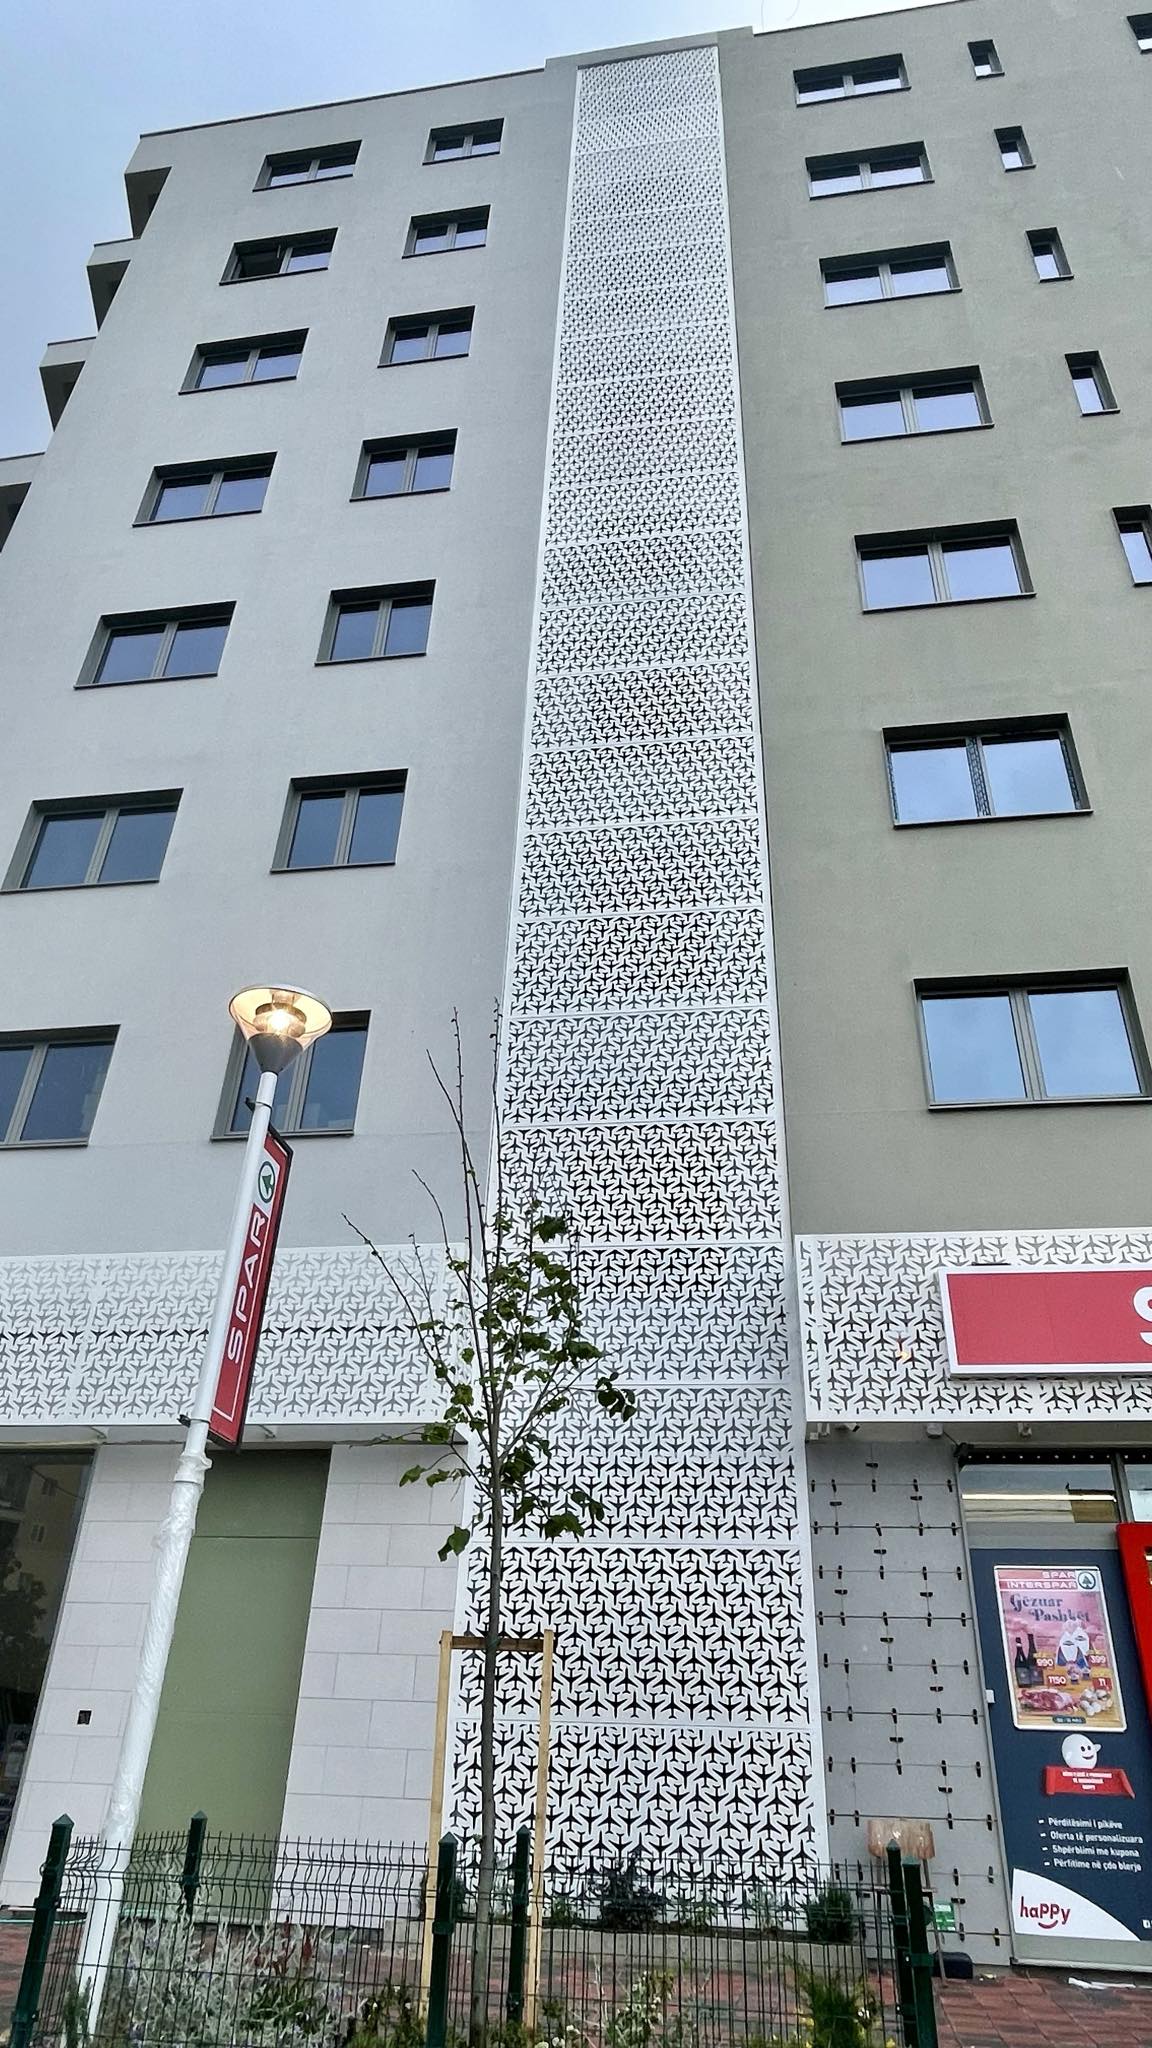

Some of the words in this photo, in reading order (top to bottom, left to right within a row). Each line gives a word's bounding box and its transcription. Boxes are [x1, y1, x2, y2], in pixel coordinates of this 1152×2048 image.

[227, 1211, 266, 1364] SPAR
[1041, 1571, 1076, 1579] SPAR
[1007, 1581, 1077, 1589] INTERSPAR
[1048, 1675, 1066, 1685] 1150
[1050, 1831, 1075, 1840] Oferta
[1085, 1834, 1143, 1844] personalizuara
[1096, 1848, 1109, 1856] me
[1110, 1847, 1140, 1858] kupona
[1118, 1861, 1142, 1872] blerje
